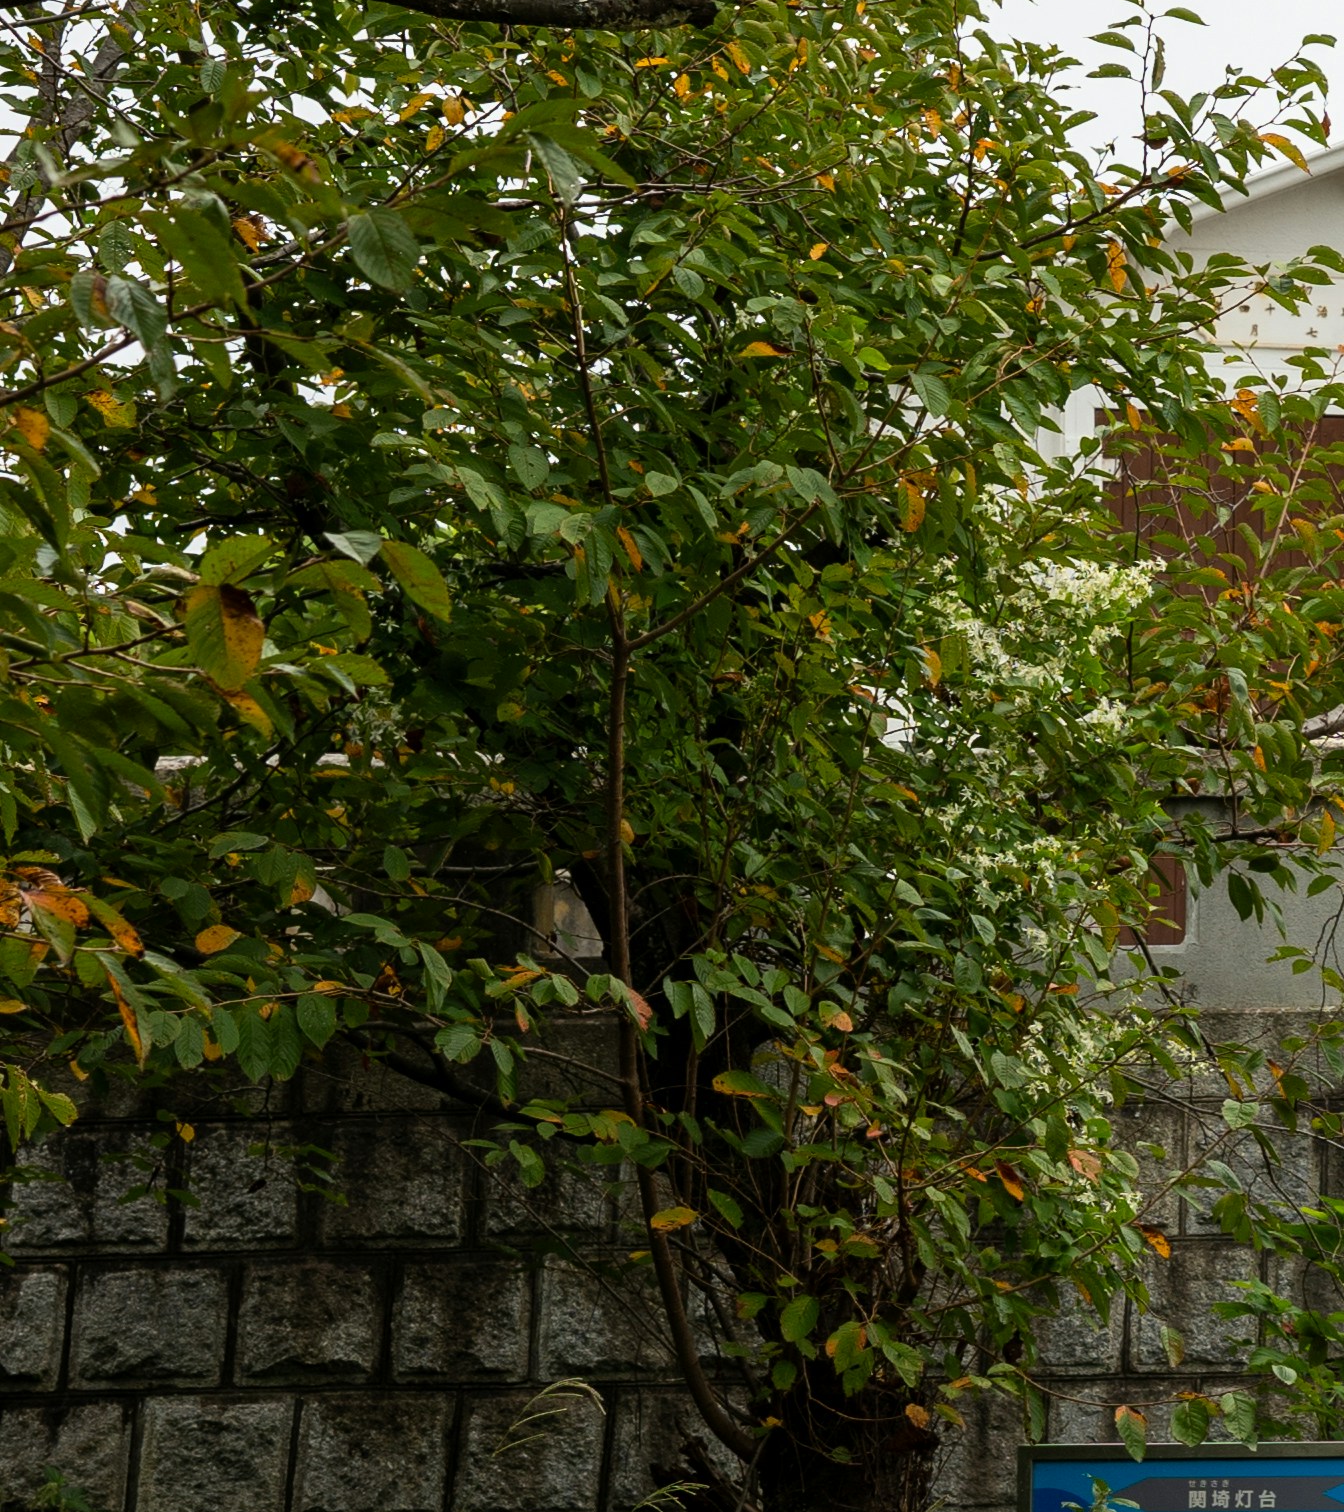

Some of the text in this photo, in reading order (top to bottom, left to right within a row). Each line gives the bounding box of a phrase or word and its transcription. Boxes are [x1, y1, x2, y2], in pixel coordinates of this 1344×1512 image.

[1188, 1480, 1231, 1488] せきさき
[1188, 1490, 1277, 1509] 関埼灯台
